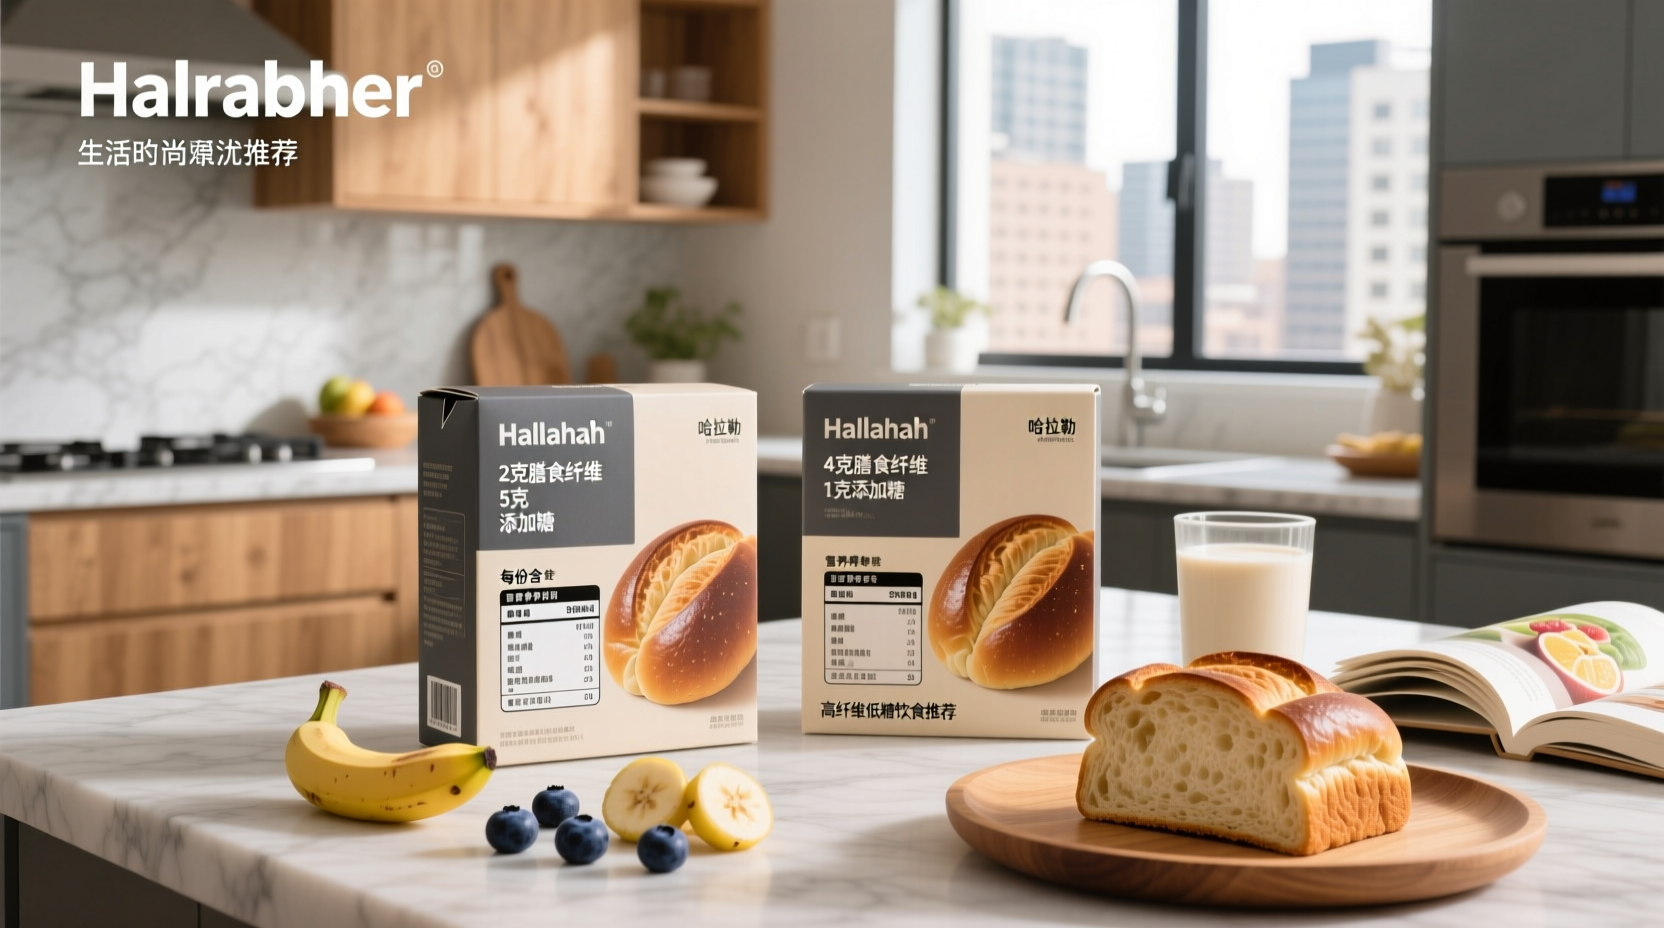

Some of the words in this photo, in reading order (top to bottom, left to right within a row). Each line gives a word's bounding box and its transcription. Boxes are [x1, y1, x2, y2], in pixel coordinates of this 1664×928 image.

[499, 420, 605, 446] Hallahah
[824, 416, 929, 440] Hallahah
[499, 461, 603, 484] 2克膳食纤维
[823, 453, 929, 475] 4克膳食纤维
[500, 486, 529, 509] 5克
